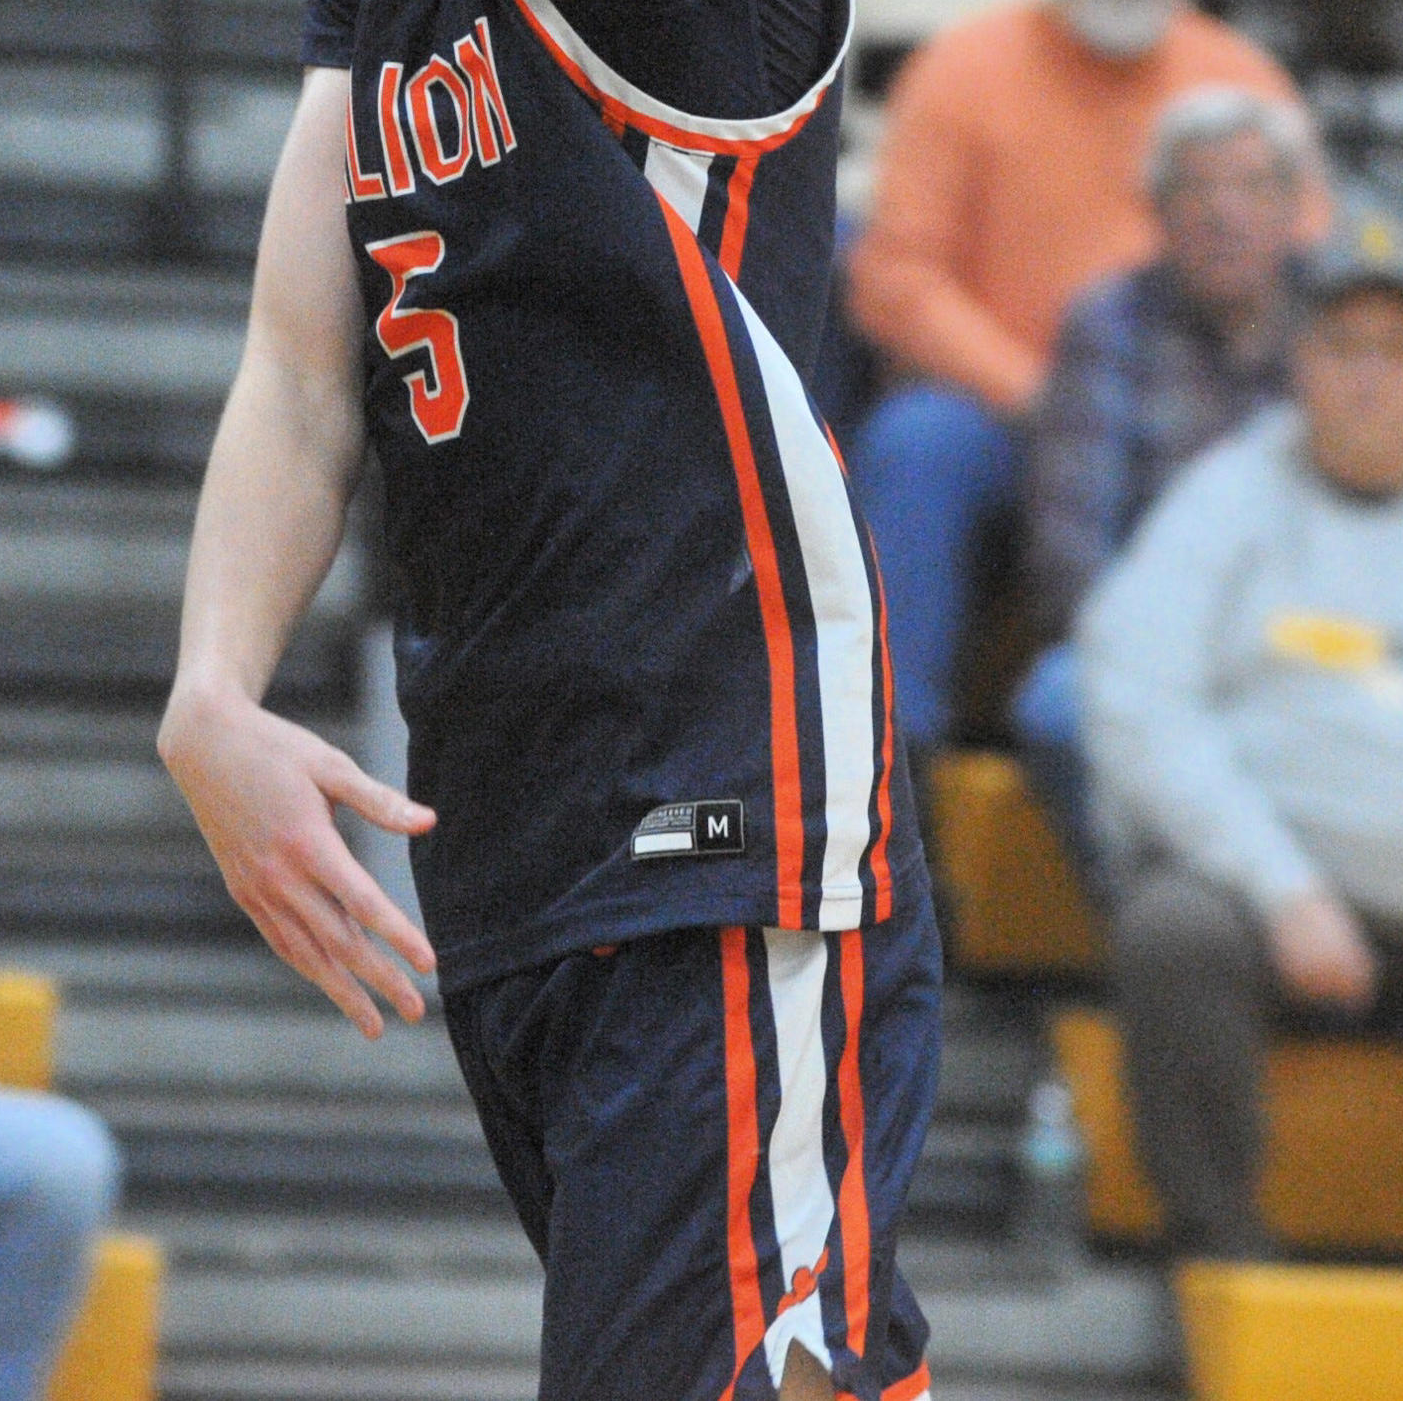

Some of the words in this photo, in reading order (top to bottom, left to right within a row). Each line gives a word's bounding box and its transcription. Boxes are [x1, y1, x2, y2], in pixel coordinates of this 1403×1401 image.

[344, 16, 517, 204] LION
[364, 230, 470, 446] 5
[707, 814, 729, 840] M
